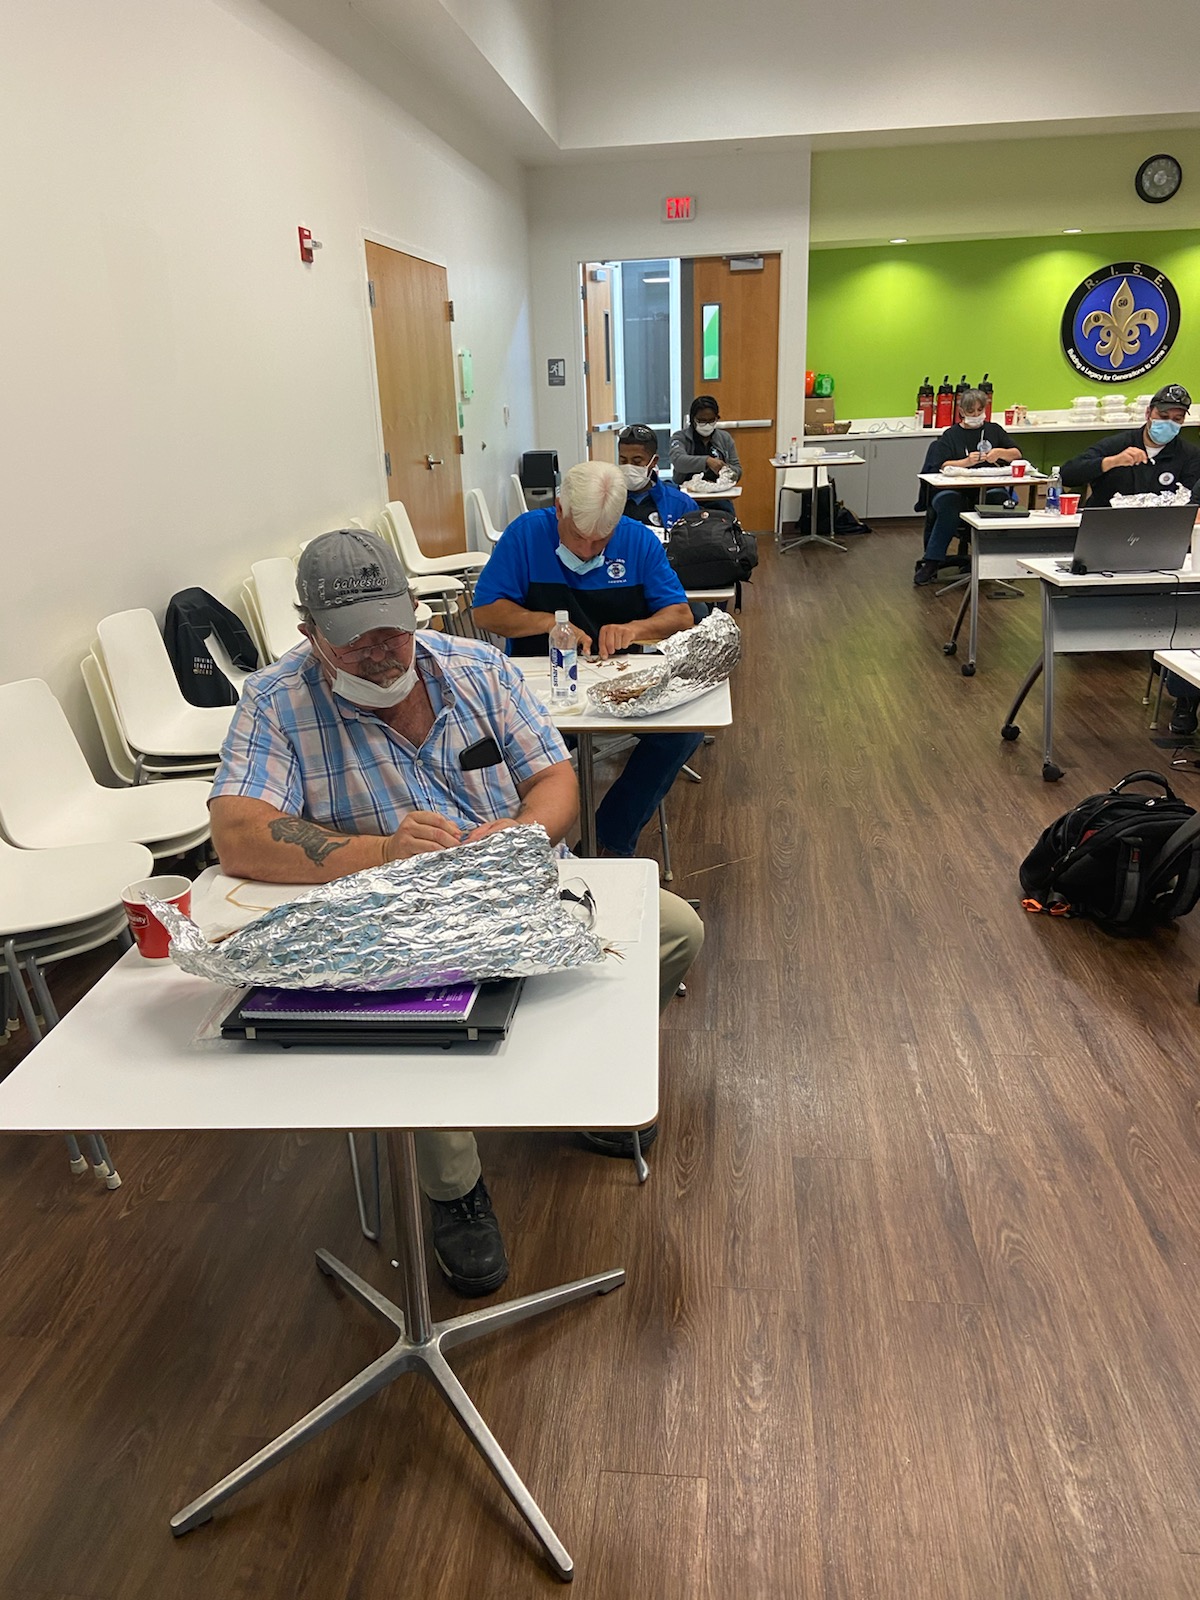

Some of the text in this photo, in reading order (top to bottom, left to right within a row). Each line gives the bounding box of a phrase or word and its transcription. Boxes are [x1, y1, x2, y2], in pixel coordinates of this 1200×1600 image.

[666, 197, 691, 218] EXIT
[1085, 368, 1103, 380] Legacy
[1112, 367, 1145, 381] Generations
[1150, 350, 1165, 364] Come
[333, 577, 388, 590] Galveston
